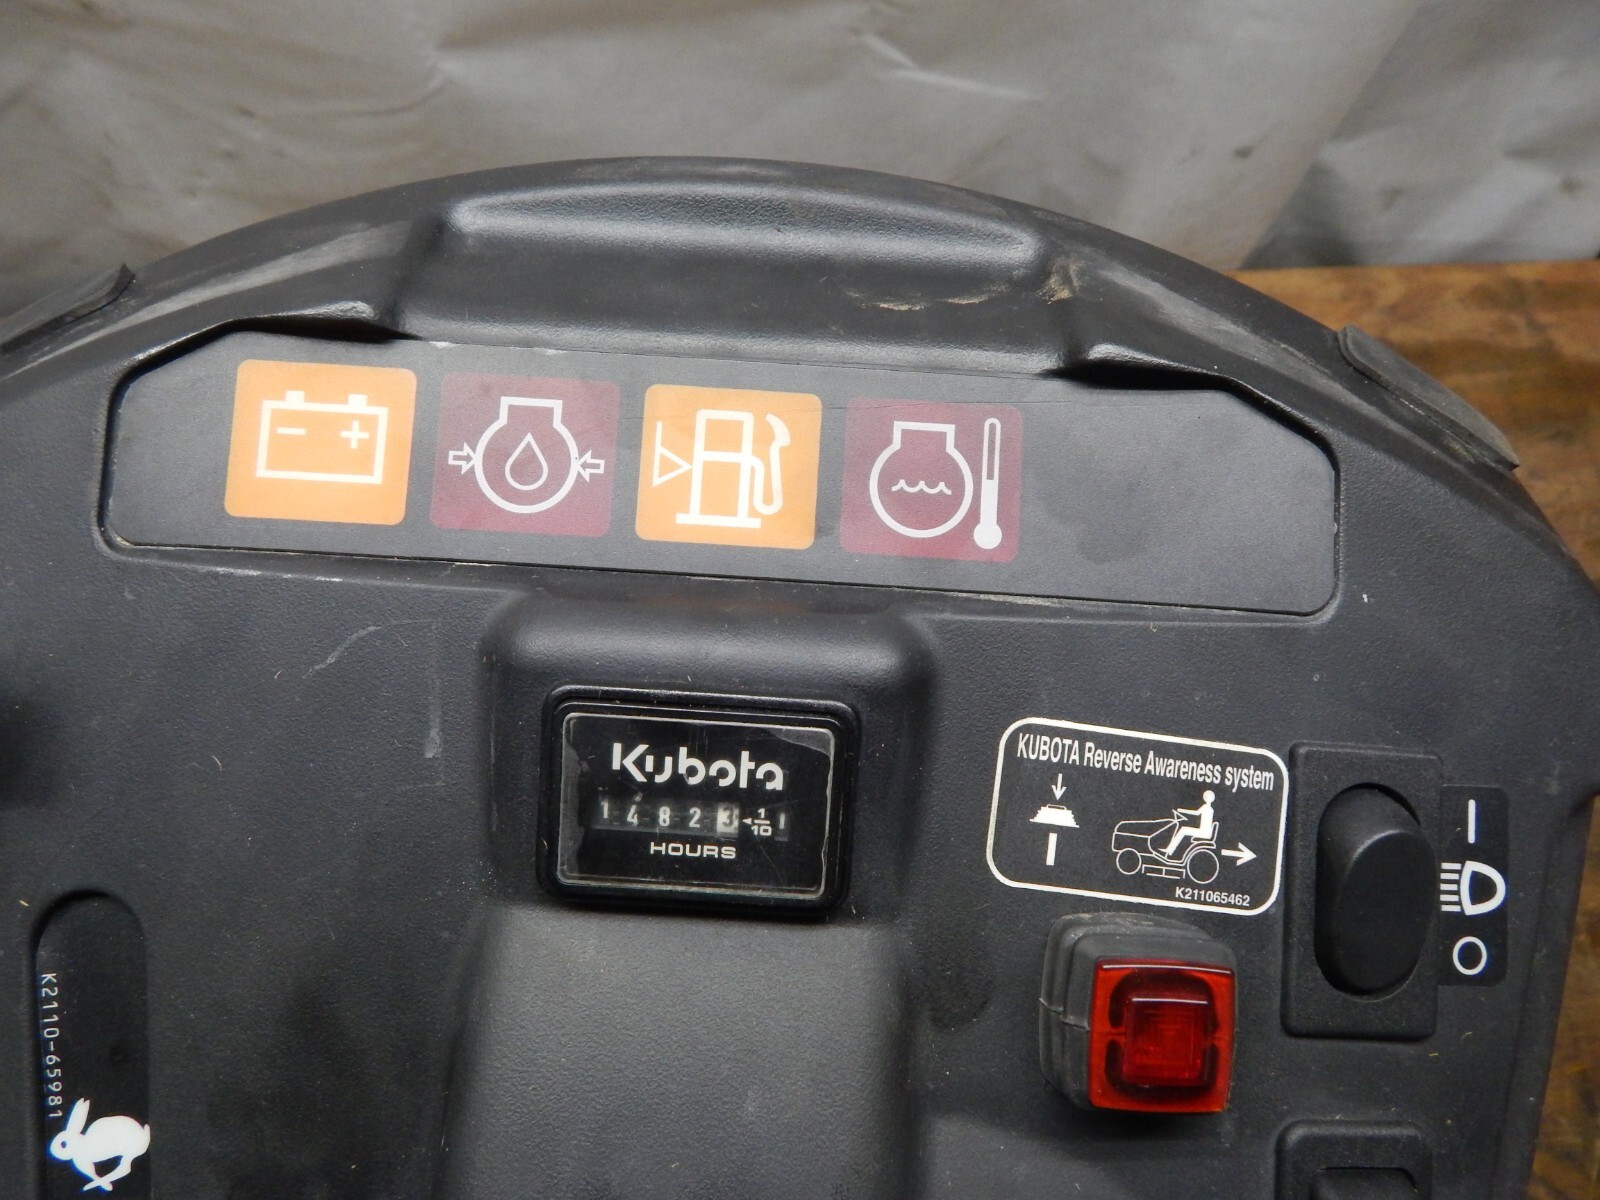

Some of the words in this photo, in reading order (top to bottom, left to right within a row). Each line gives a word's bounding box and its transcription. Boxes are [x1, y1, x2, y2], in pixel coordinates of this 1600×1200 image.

[612, 742, 785, 791] Kubota
[1017, 733, 1080, 765] KUBOTA
[1083, 742, 1142, 774] Reverse
[1144, 751, 1222, 786] Awareness
[1224, 765, 1275, 793] system
[650, 841, 737, 859] HOURS
[1175, 886, 1250, 907] K211065462
[41, 973, 63, 1118] K2110-65981
